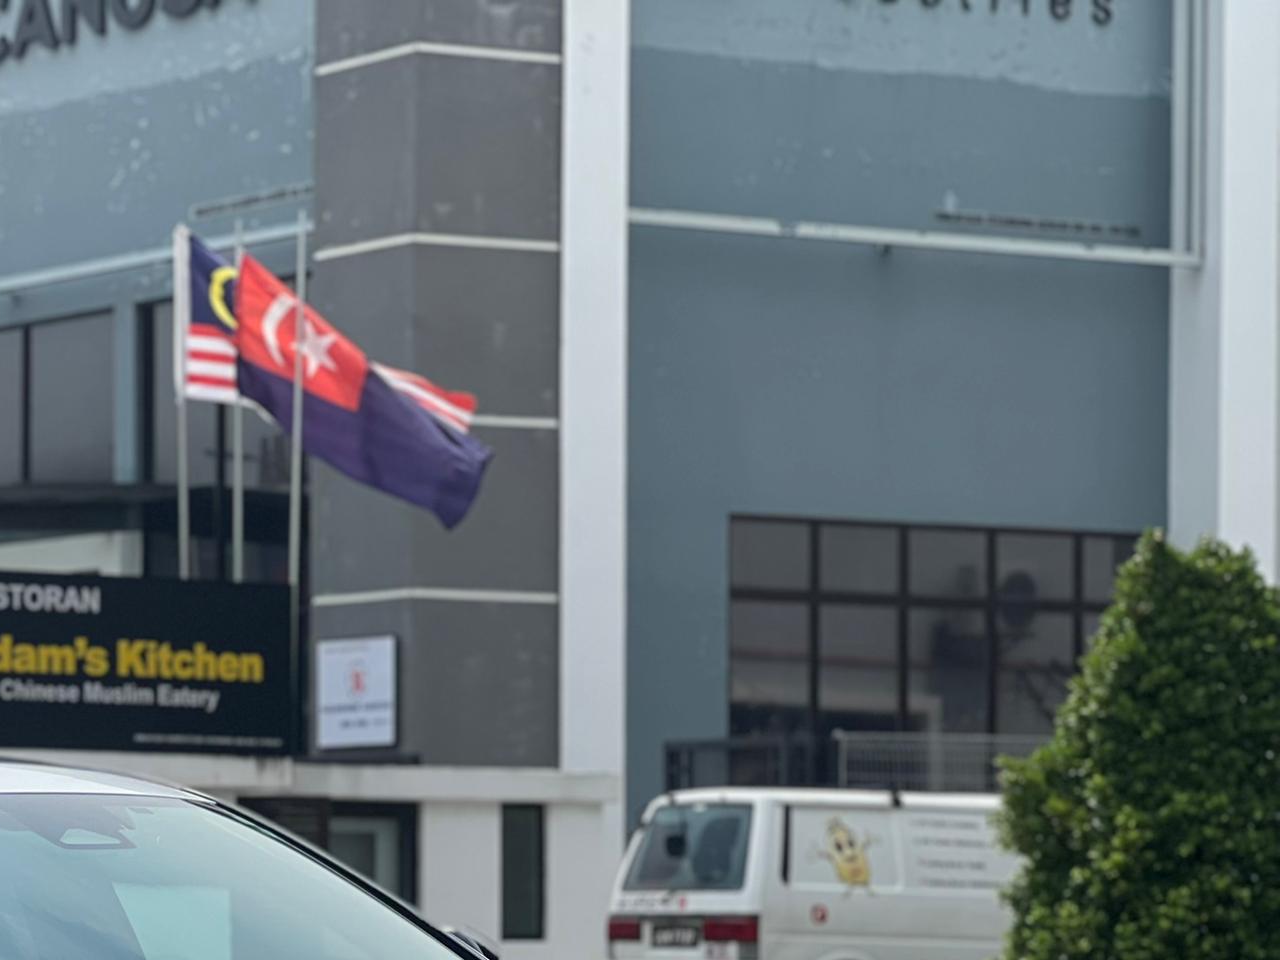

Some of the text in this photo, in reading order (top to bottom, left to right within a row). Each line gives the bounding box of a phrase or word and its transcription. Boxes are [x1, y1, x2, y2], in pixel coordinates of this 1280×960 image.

[116, 638, 265, 683] Kitchen
[83, 681, 154, 706] Muslim
[157, 684, 220, 713] Eatery
